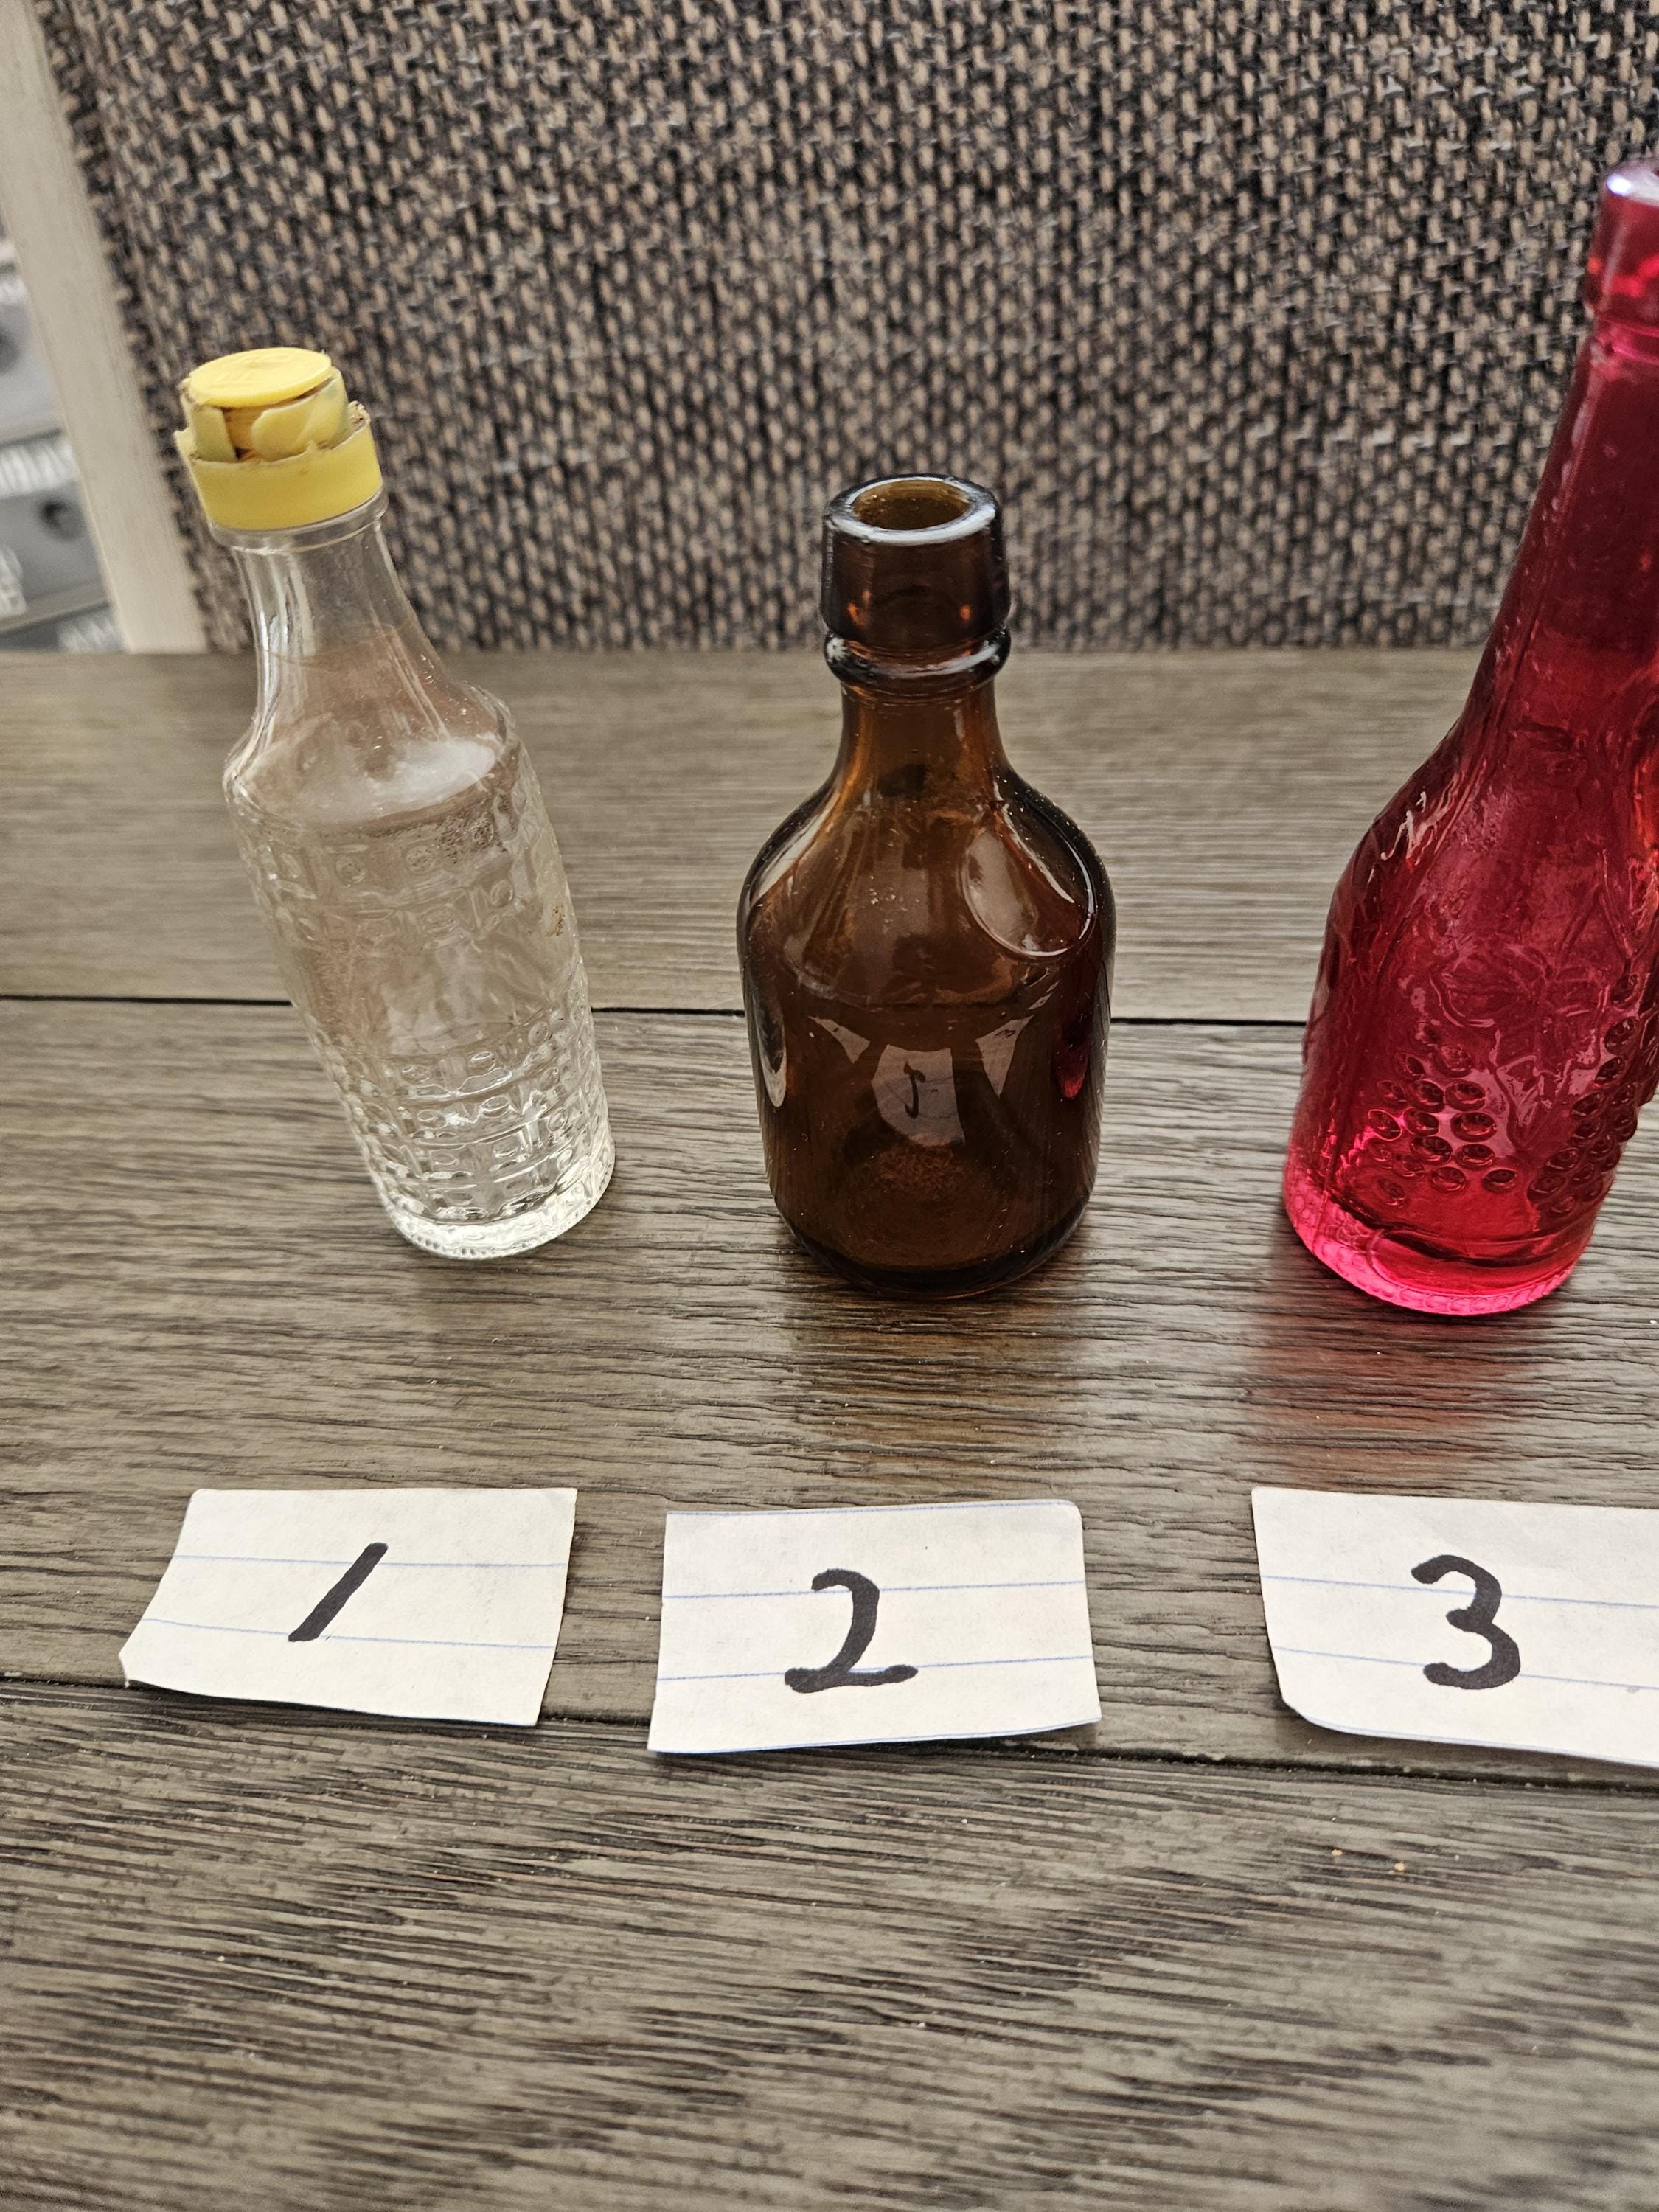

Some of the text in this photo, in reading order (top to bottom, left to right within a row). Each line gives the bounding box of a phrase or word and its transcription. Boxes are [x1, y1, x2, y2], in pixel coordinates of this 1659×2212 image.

[288, 1543, 387, 1642] 1
[785, 1569, 918, 1694] 2
[1411, 1555, 1521, 1690] 3
